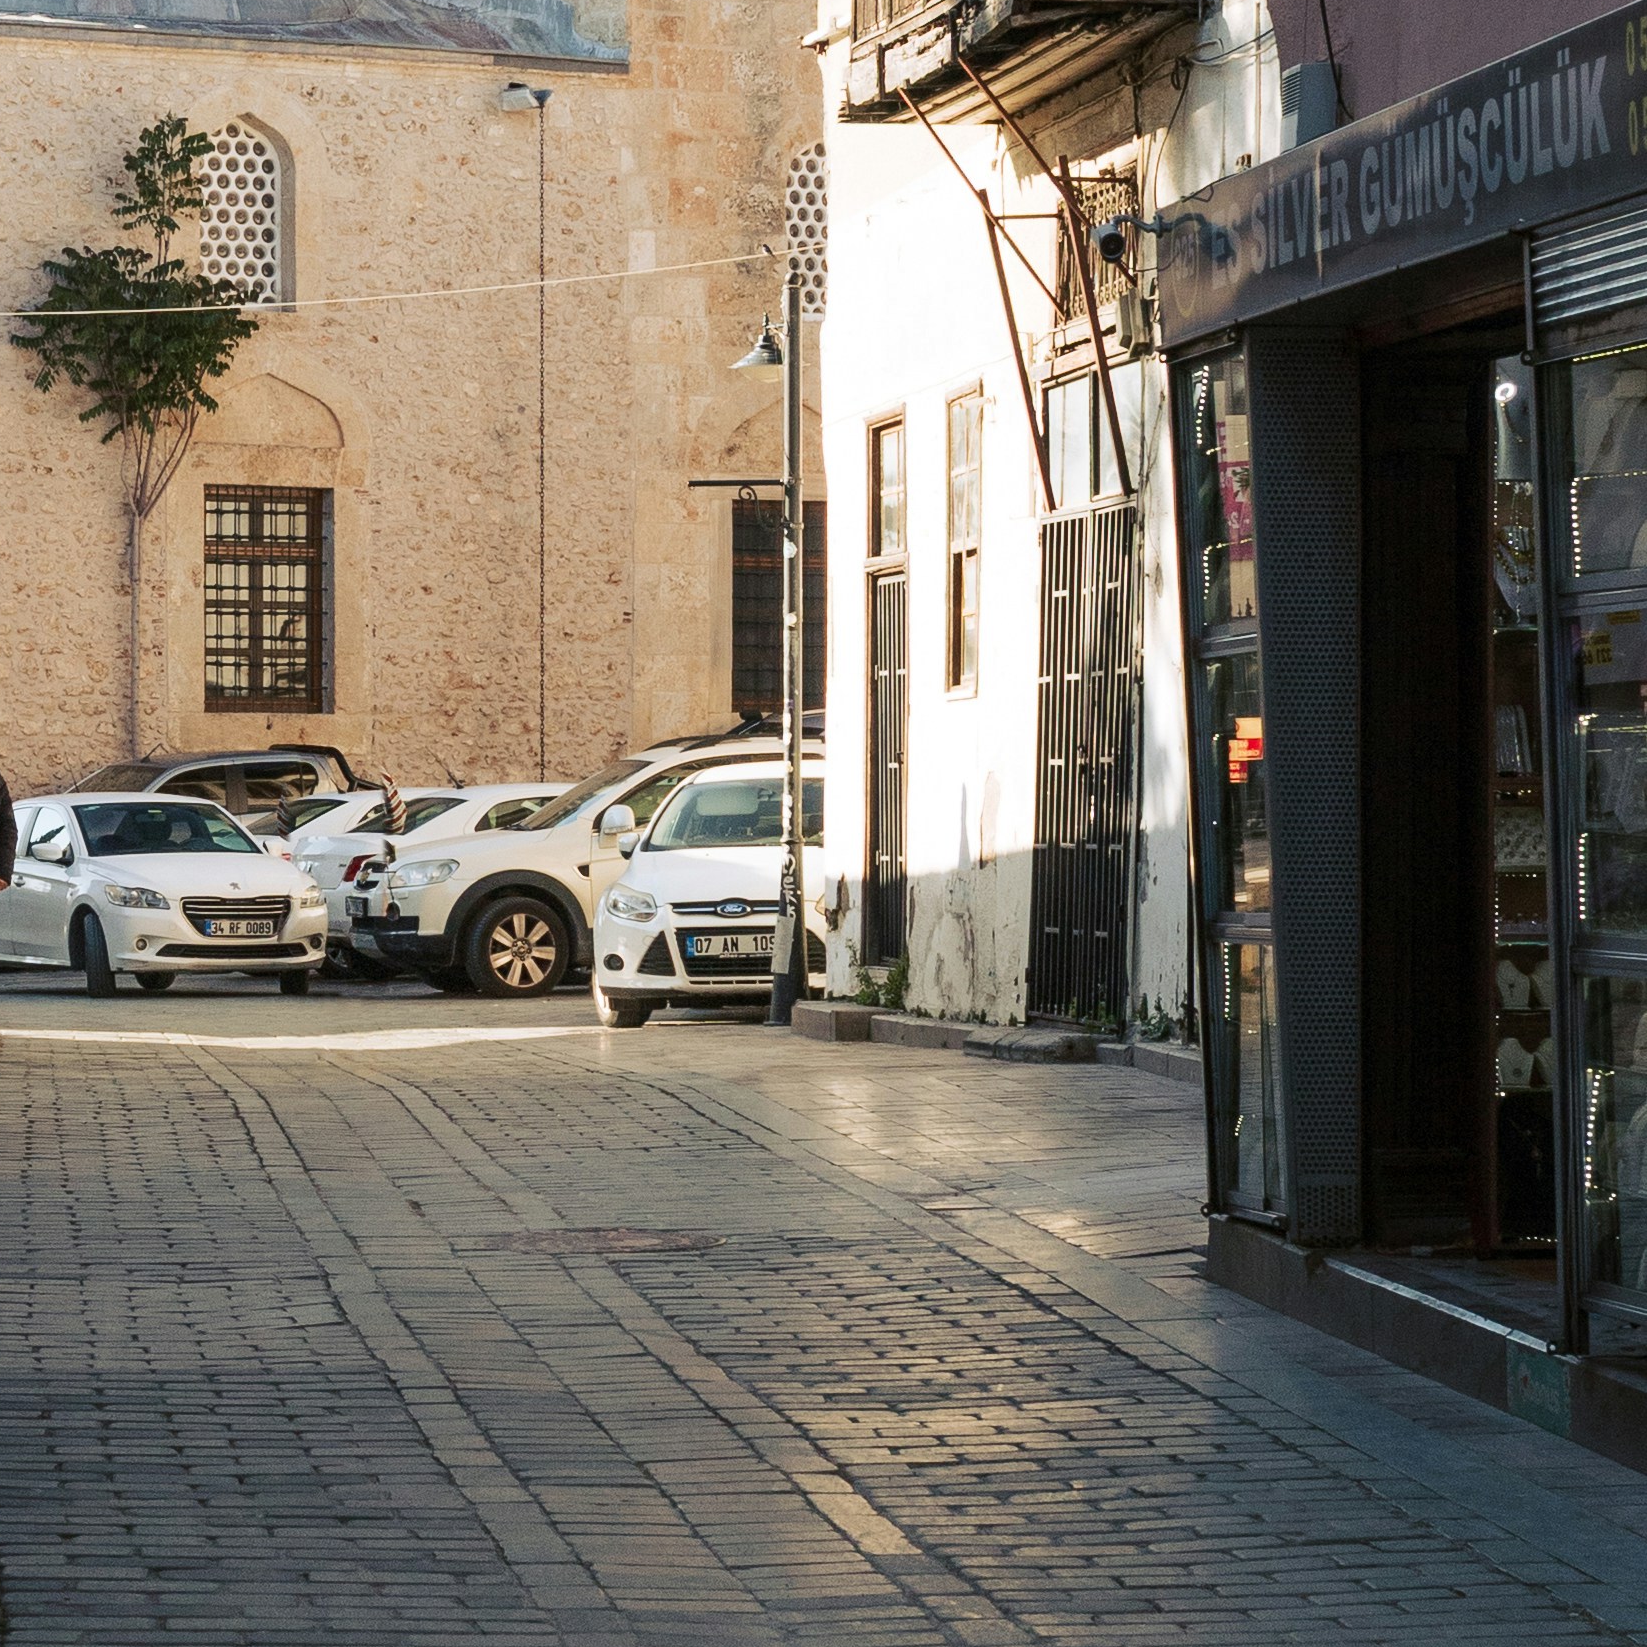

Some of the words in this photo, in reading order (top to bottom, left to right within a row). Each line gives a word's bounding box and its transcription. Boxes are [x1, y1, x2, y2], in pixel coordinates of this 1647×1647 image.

[1251, 157, 1352, 275] SİLVER
[1359, 46, 1611, 236] GÜMÜŞCÜLÜK
[723, 904, 743, 913] Ford
[211, 921, 224, 935] 34
[229, 921, 241, 935] RF
[246, 921, 271, 935] 0089
[695, 937, 712, 954] 07
[723, 936, 740, 953] AN
